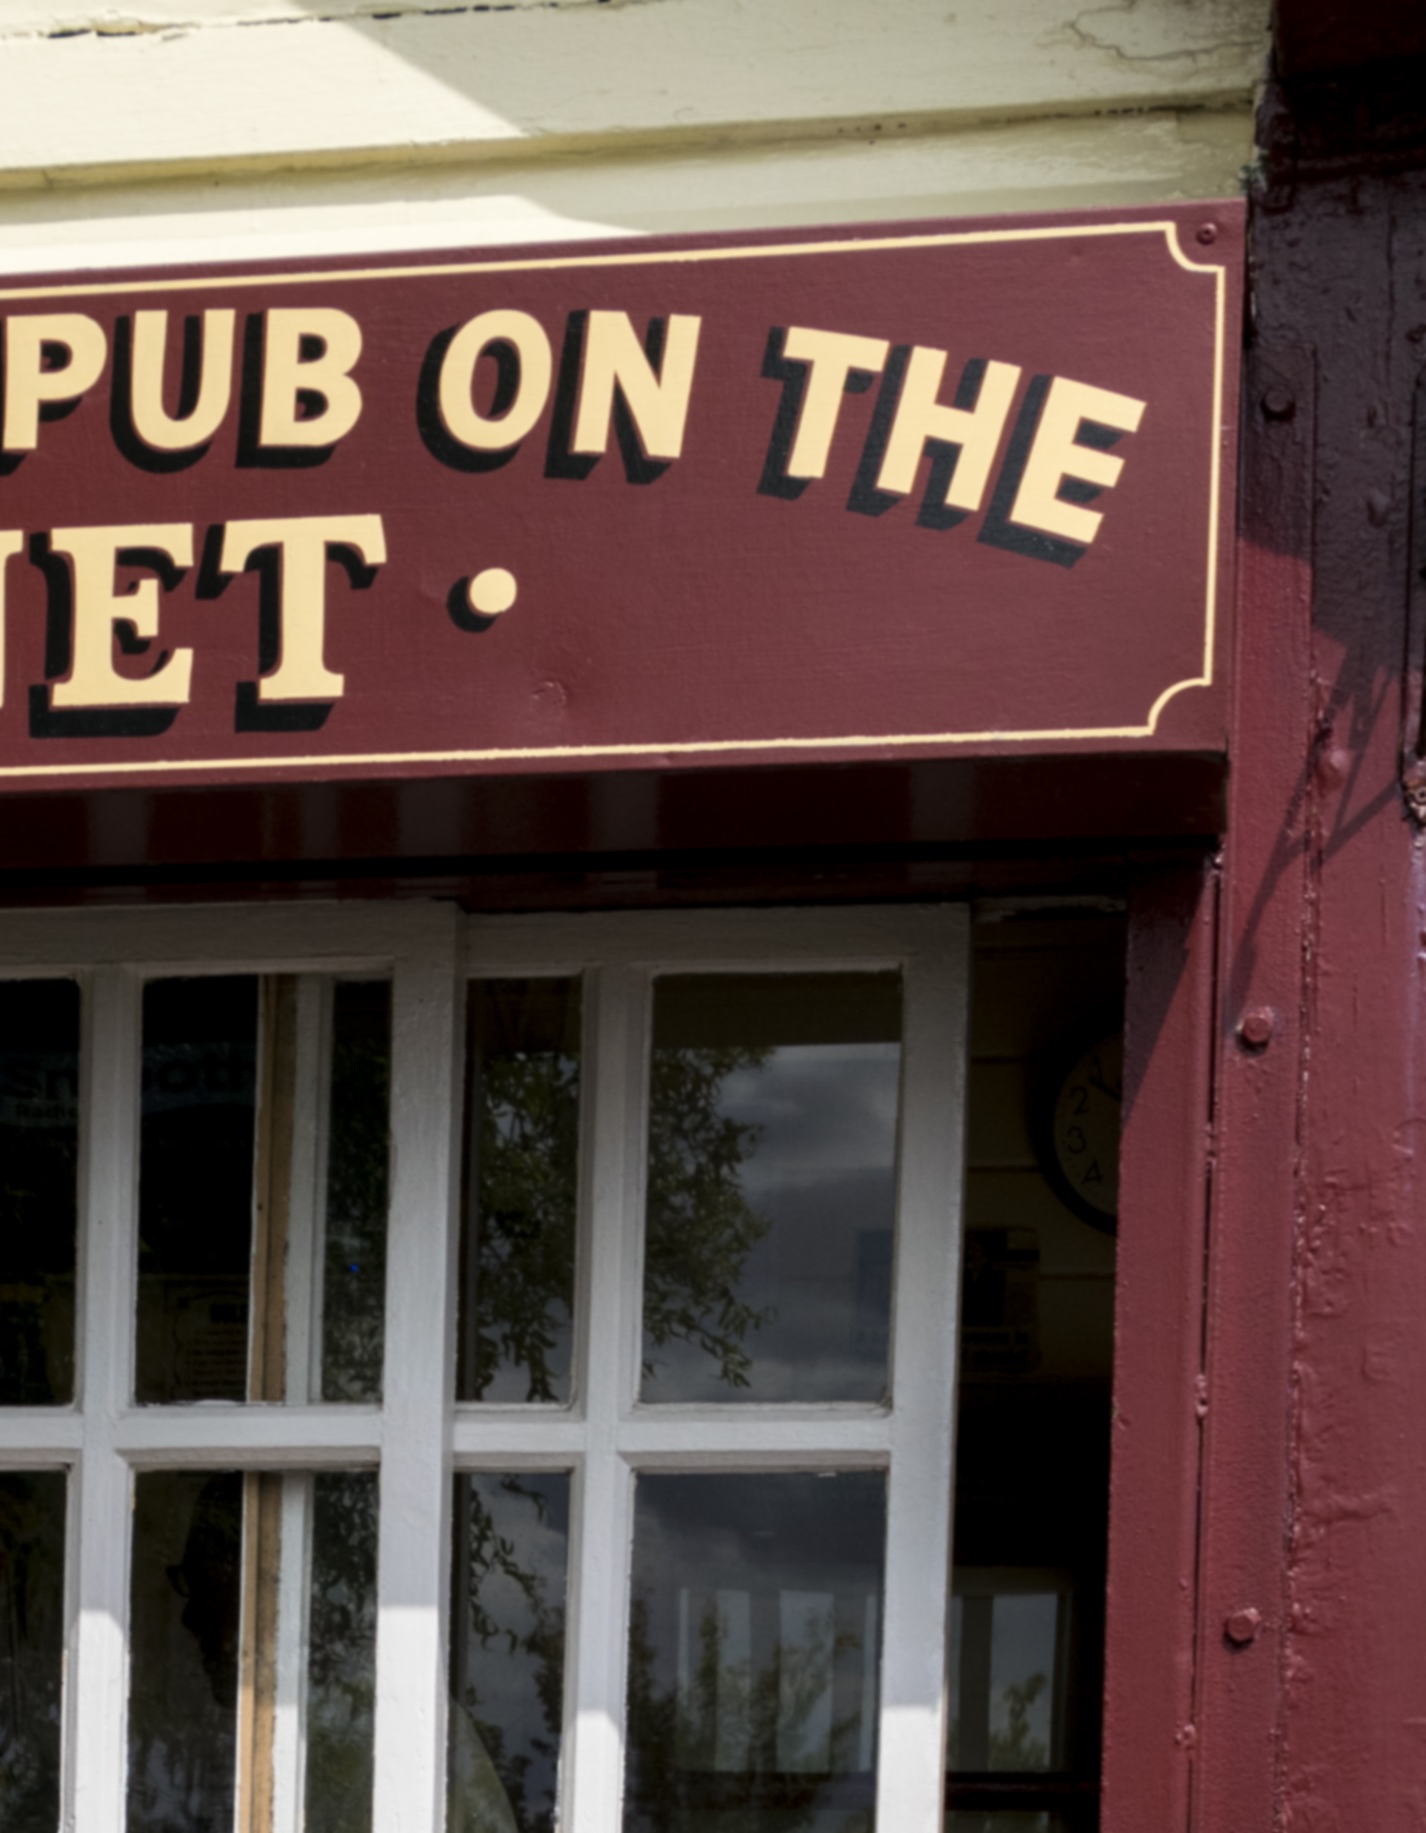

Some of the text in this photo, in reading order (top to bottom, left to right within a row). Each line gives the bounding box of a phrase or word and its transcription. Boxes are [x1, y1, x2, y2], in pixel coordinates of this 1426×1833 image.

[1, 307, 363, 450] PUB
[439, 308, 703, 460] ON
[782, 325, 1148, 545] THE
[1069, 1086, 1091, 1115] 2
[1067, 1125, 1086, 1154] 3
[1081, 1158, 1104, 1185] 4
